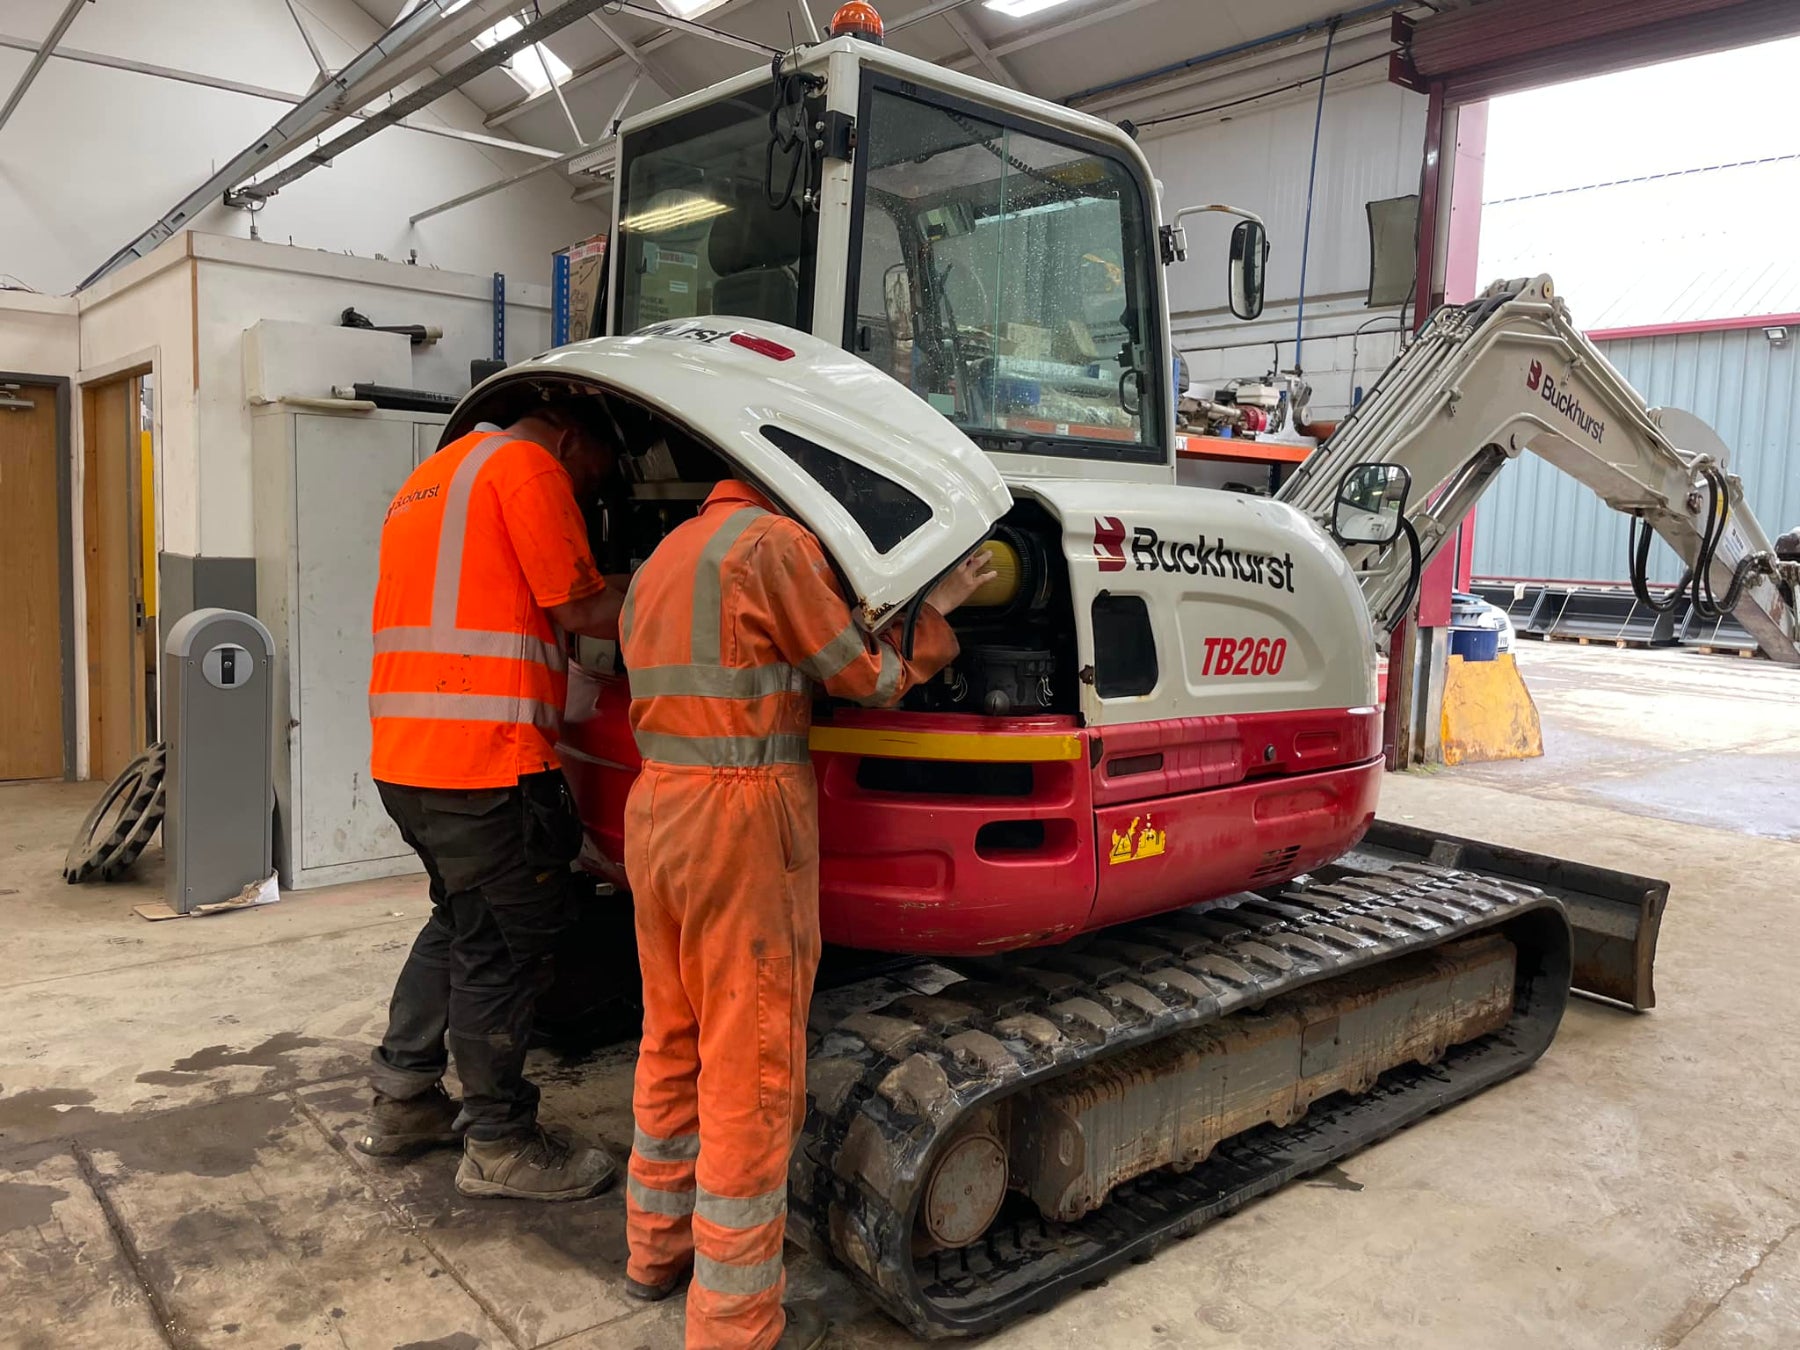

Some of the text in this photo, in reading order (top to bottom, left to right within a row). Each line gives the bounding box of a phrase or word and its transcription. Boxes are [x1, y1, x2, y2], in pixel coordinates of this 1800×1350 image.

[1541, 373, 1605, 444] Buckhurst
[1131, 526, 1295, 593] Buckhurst
[1201, 636, 1287, 676] TB260
